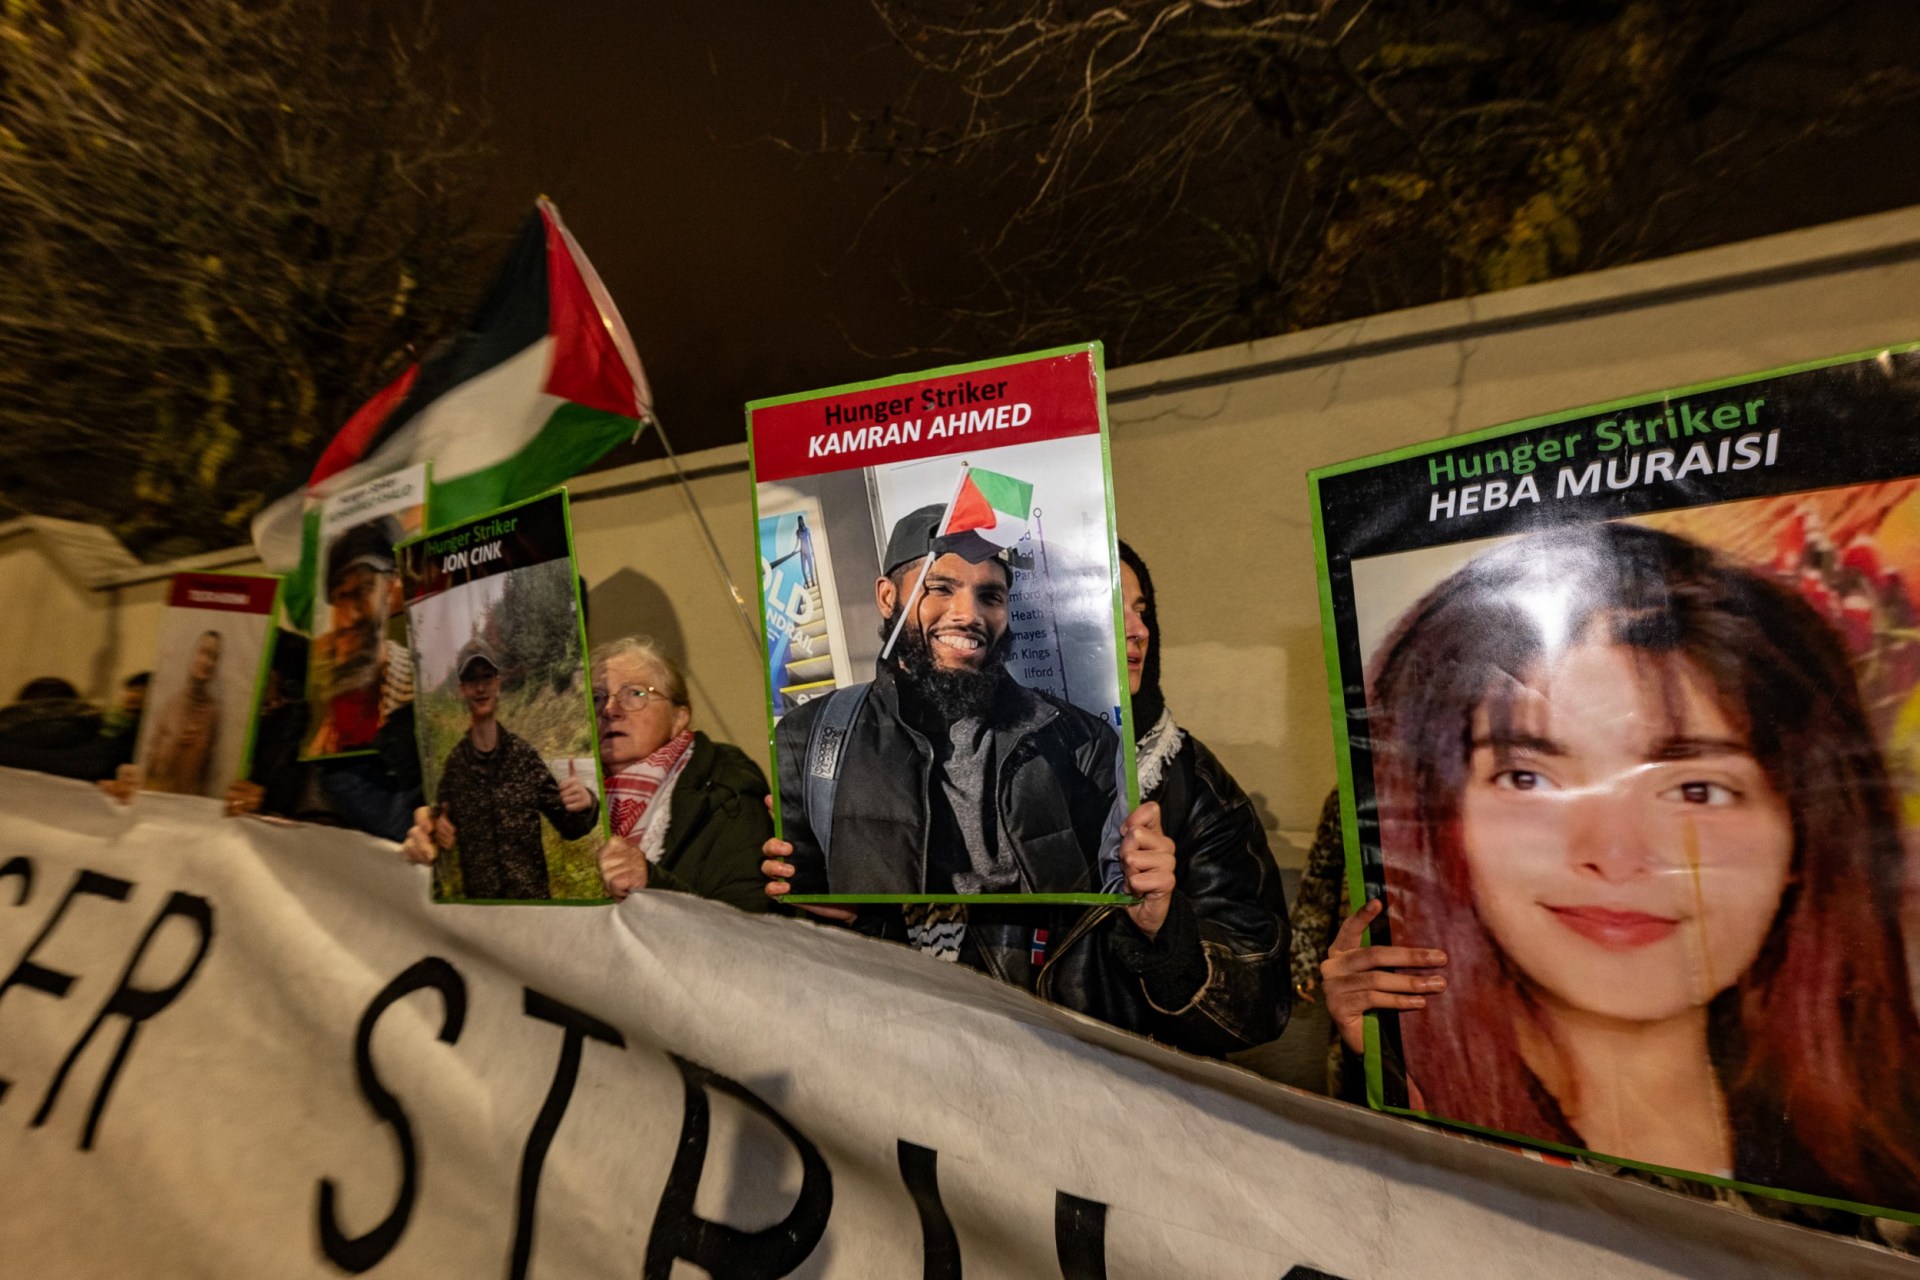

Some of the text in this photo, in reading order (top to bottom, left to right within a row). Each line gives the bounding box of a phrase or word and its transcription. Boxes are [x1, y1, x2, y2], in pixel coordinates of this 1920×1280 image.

[825, 380, 1008, 426] Hunger Striker
[808, 403, 1032, 458] KAMRAN AHMED
[1428, 399, 1766, 485] Hunger Striker
[1428, 428, 1781, 522] HEBA MURAISI
[427, 518, 518, 555] Hunger Striker
[442, 540, 503, 573] JON CINK
[1009, 589, 1040, 602] mford
[1011, 608, 1044, 622] Heath
[1021, 649, 1050, 661] Kings
[1024, 667, 1053, 679] Ilford
[0, 856, 214, 1150] ER
